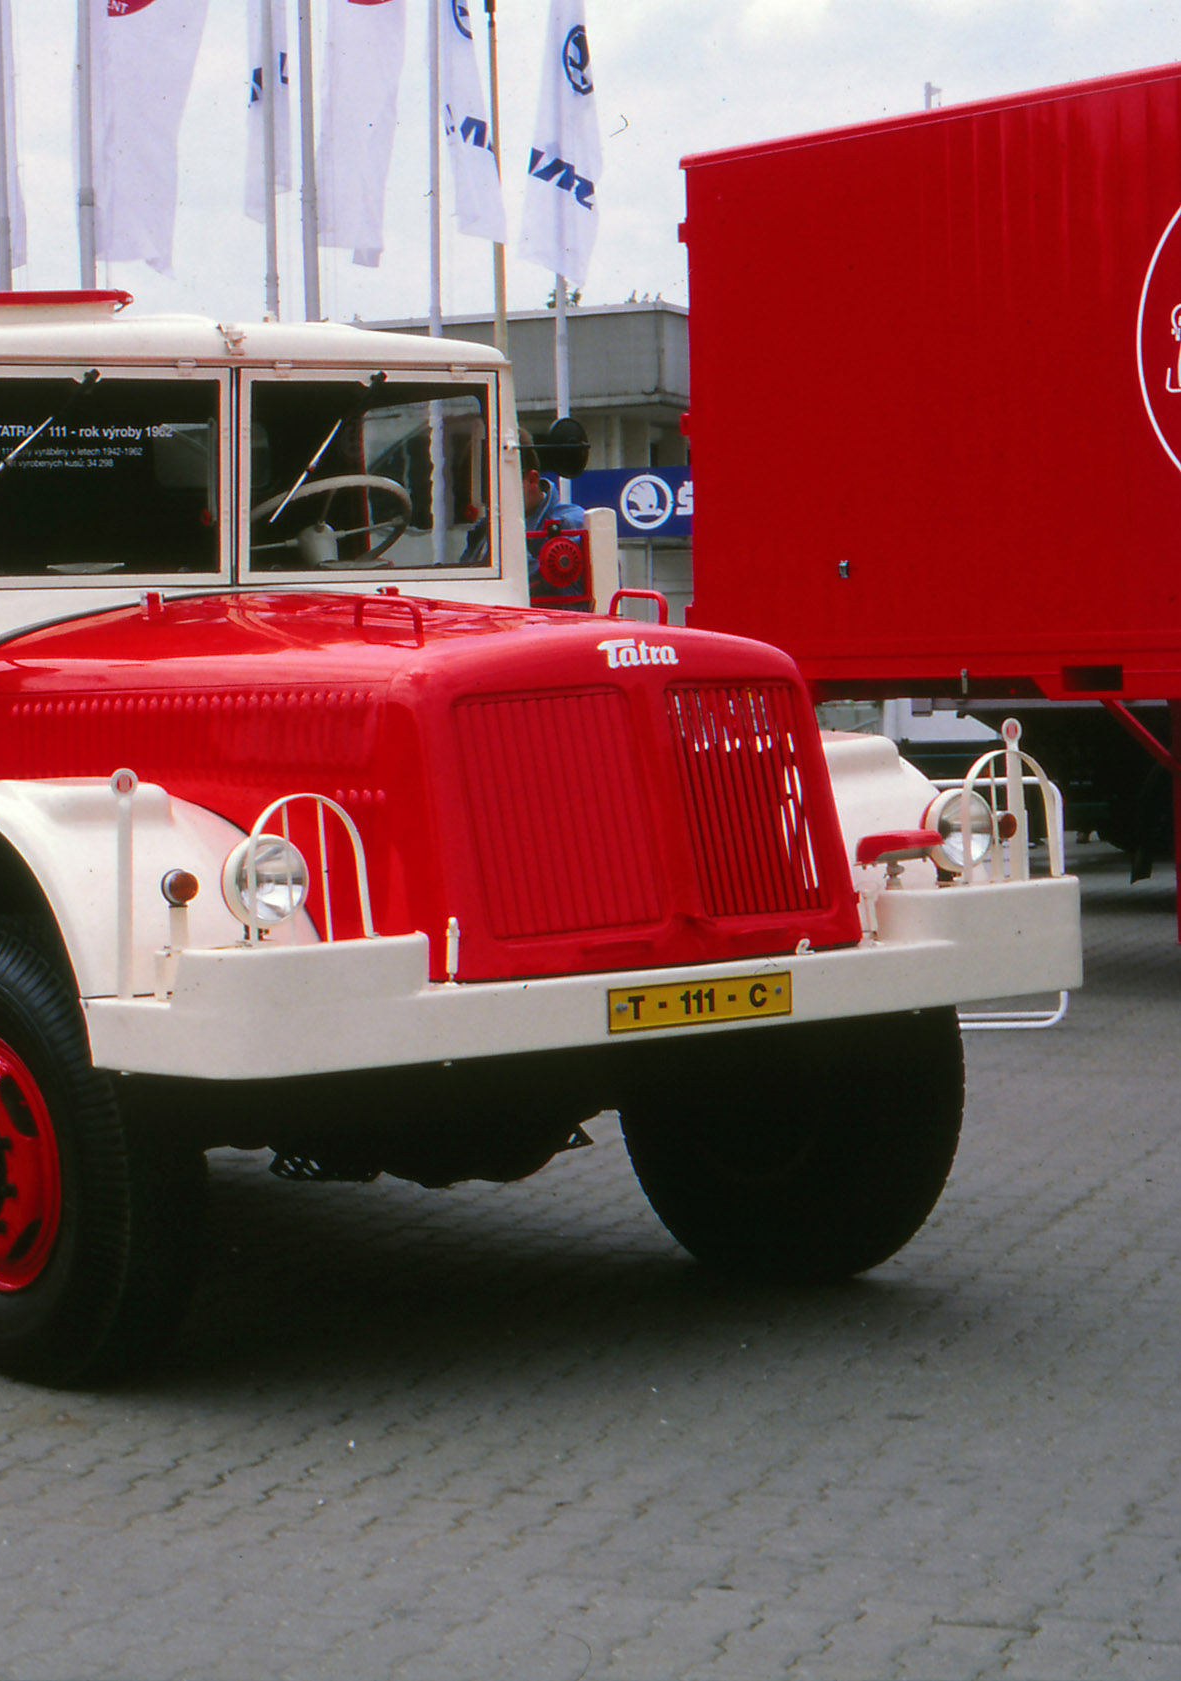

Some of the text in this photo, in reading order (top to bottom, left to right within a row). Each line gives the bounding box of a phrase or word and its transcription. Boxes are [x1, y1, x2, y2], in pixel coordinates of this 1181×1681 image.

[48, 425, 67, 437] 111
[78, 425, 100, 438] rok
[102, 425, 143, 440] výroby
[597, 638, 679, 669] Tatra
[627, 995, 645, 1020] T
[679, 988, 715, 1015] 111
[749, 983, 768, 1008] C
